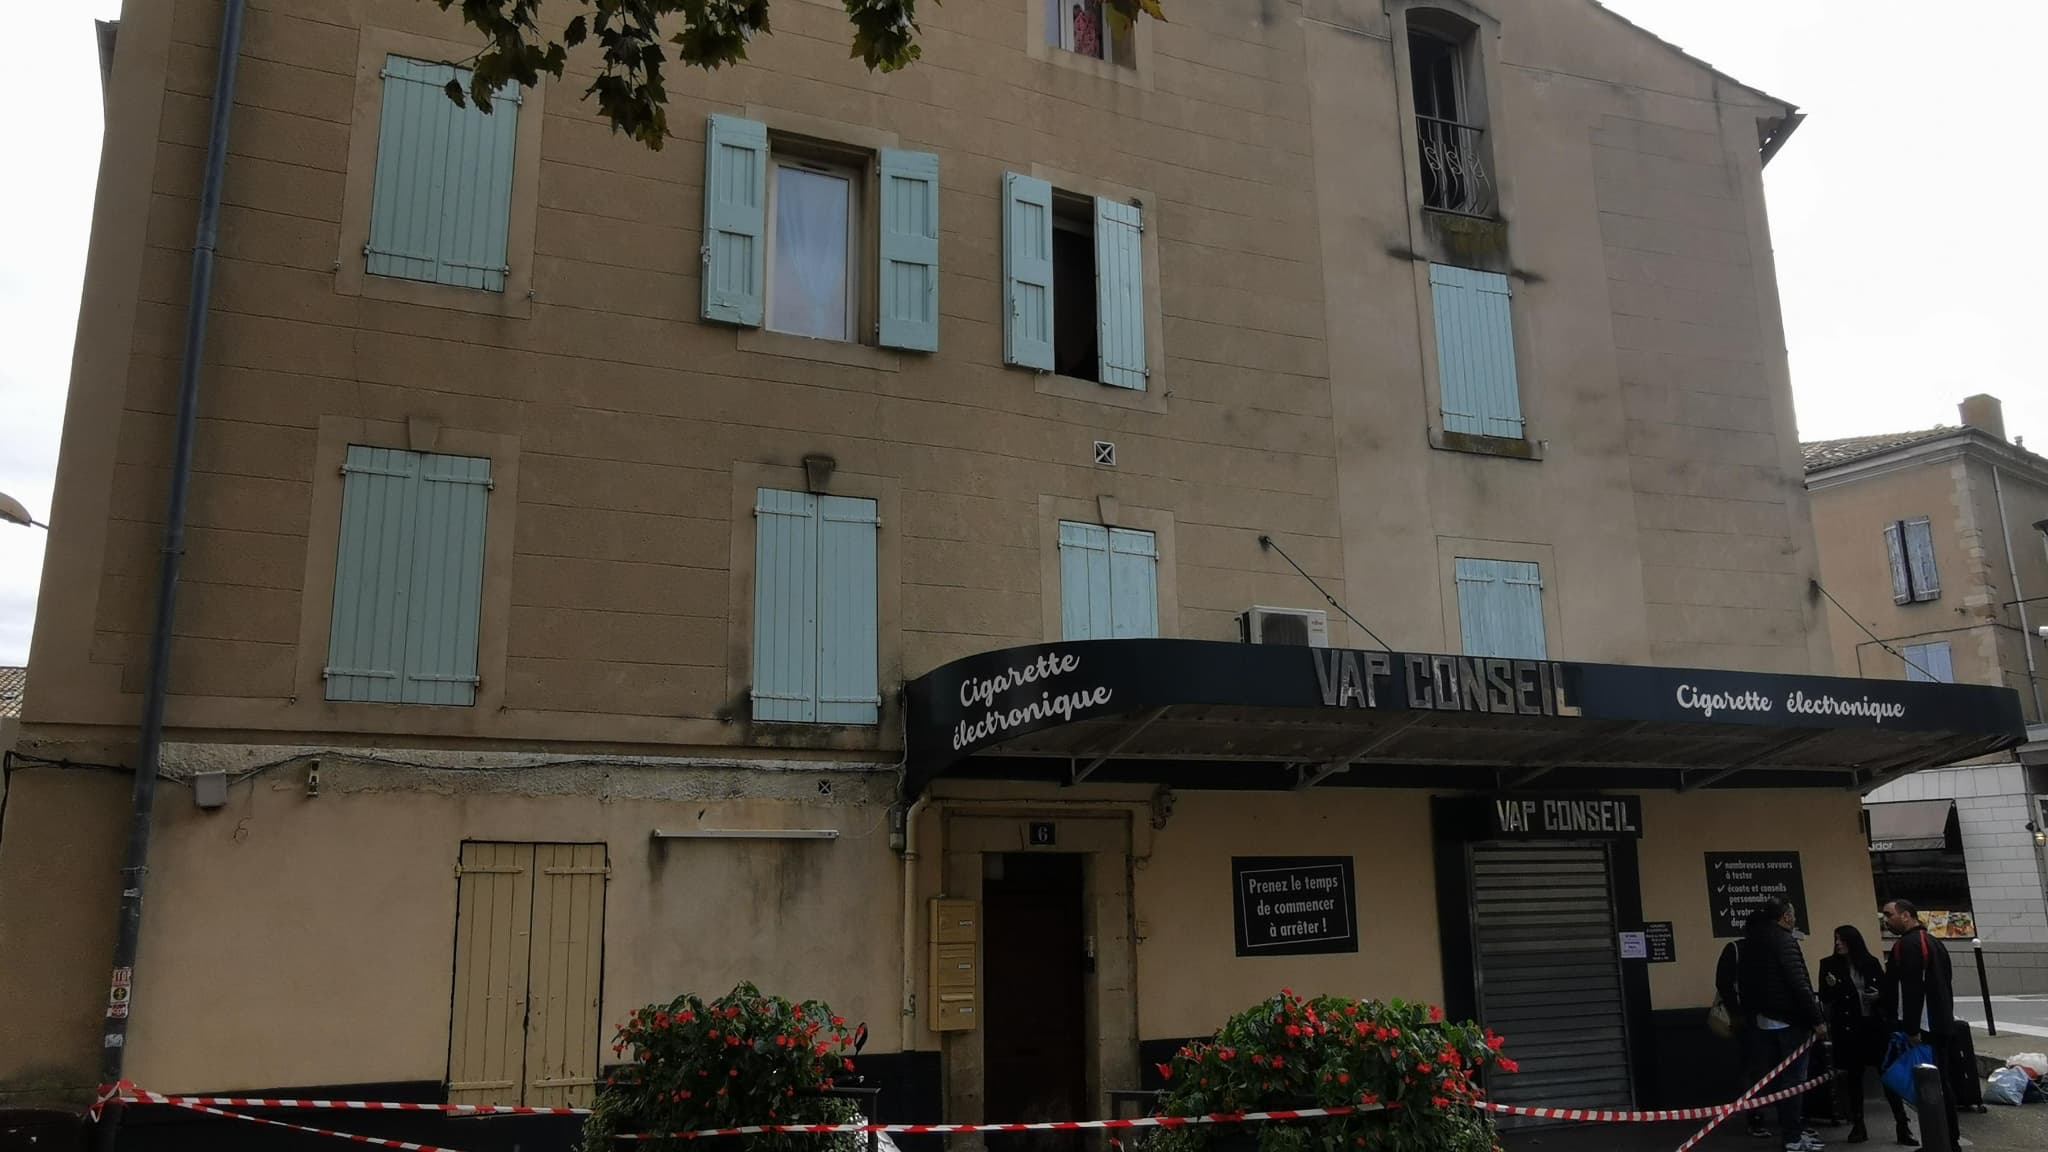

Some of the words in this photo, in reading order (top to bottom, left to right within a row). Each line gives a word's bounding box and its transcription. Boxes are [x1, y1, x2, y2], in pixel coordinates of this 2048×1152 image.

[960, 652, 1080, 707] Cigarette
[1312, 648, 1391, 708] VAP
[1404, 653, 1582, 717] CONSEIL
[1676, 684, 1772, 717] Cigarette
[1786, 690, 1905, 723] électronique
[953, 686, 1112, 750] électronique
[1496, 800, 1536, 831] VAP
[1543, 800, 1635, 831] CONSEIL
[1038, 827, 1048, 841] 6
[1249, 879, 1288, 894] Prenez
[1291, 874, 1301, 891] le
[1305, 876, 1338, 893] temps
[1752, 884, 1759, 892] et
[1760, 883, 1786, 892] conseils
[1257, 899, 1271, 916] de
[1274, 898, 1335, 914] commencer
[1729, 894, 1775, 905] personnalis
[1269, 922, 1277, 937] à
[1280, 920, 1319, 936] arrêter
[1322, 917, 1327, 933] !
